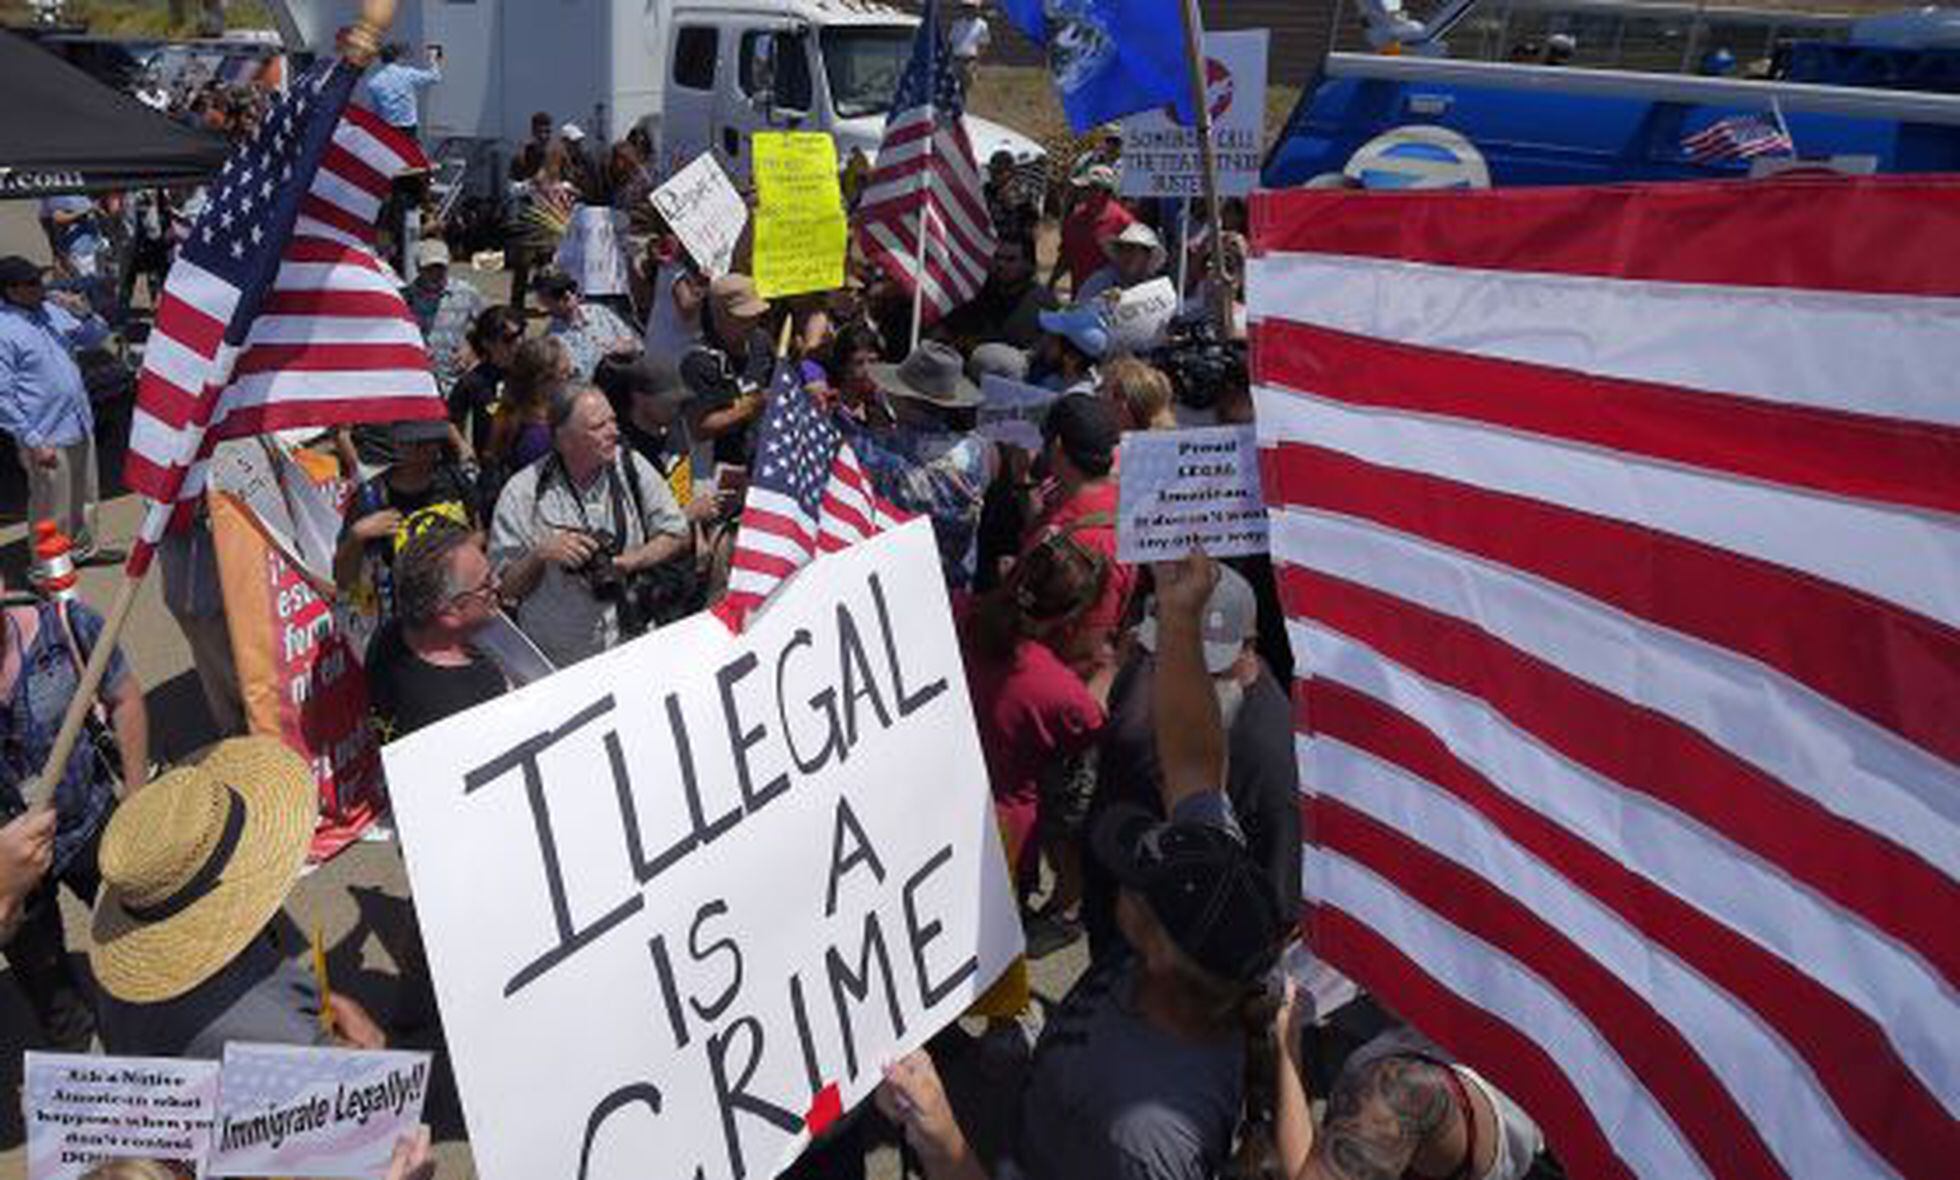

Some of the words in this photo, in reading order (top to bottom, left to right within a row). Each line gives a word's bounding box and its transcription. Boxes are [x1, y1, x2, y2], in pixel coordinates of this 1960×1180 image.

[1178, 440, 1237, 456] Proud
[1178, 462, 1237, 478] LEGAL
[464, 572, 948, 998] ILLEGAL
[648, 899, 744, 1049] IS
[824, 795, 886, 917] A
[577, 845, 979, 1180] CRIME
[66, 1069, 102, 1084] Ask
[106, 1073, 118, 1083] a
[122, 1069, 186, 1086] Native
[52, 1088, 148, 1106] American
[153, 1095, 201, 1108] what
[220, 1094, 330, 1153] Immigrate
[335, 1062, 425, 1125] Legally!!
[37, 1109, 120, 1127] happens
[125, 1114, 179, 1129] when
